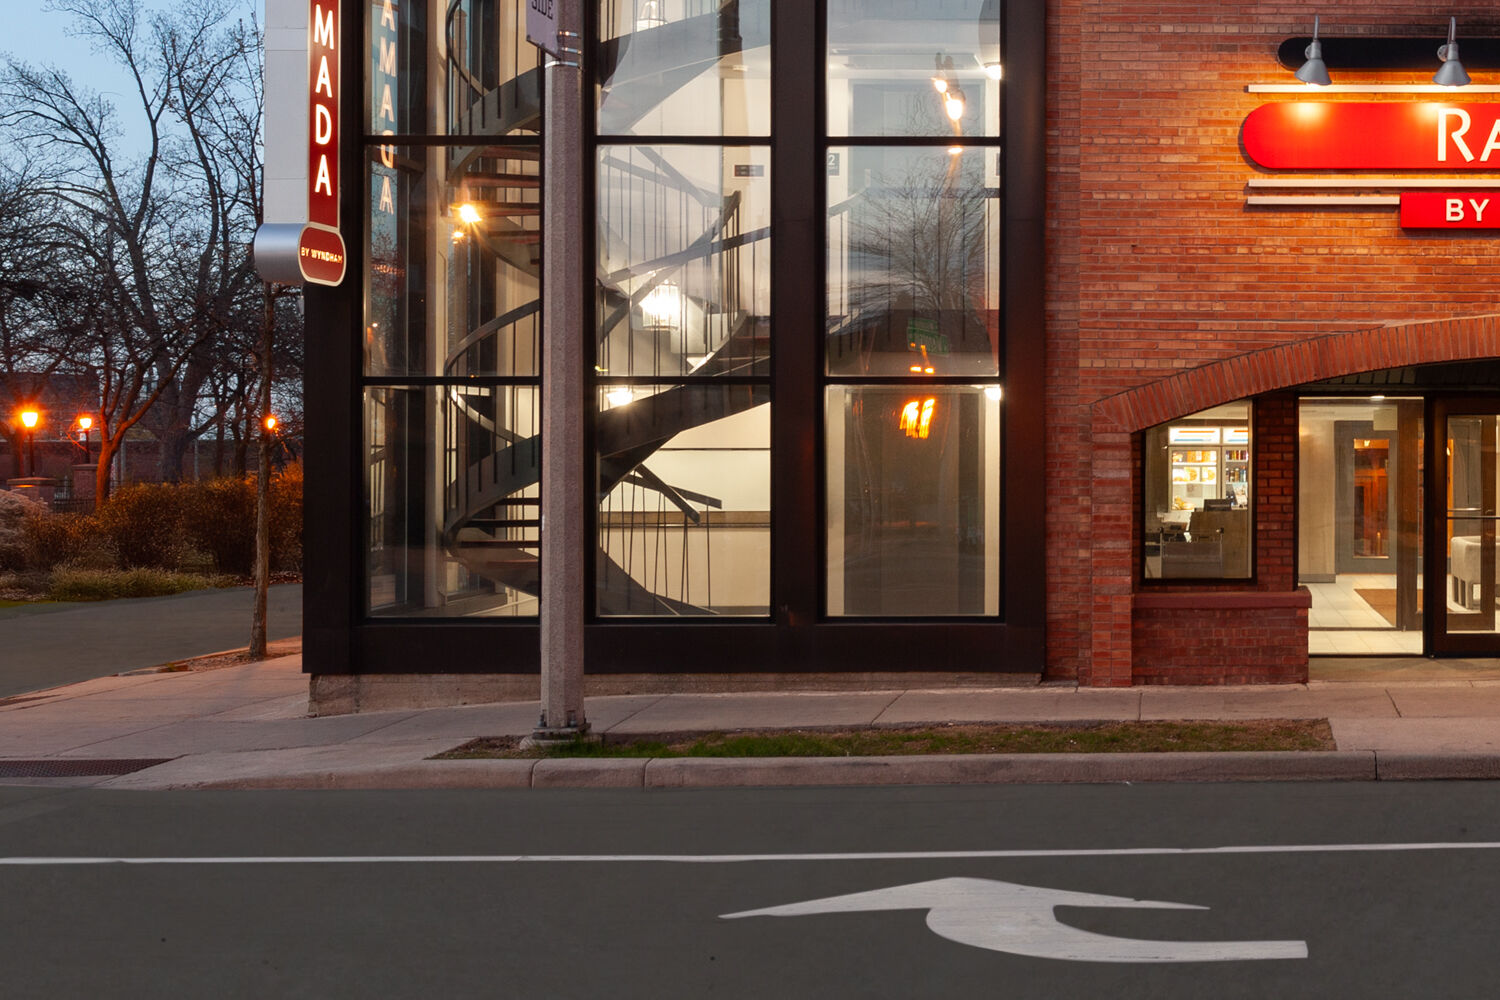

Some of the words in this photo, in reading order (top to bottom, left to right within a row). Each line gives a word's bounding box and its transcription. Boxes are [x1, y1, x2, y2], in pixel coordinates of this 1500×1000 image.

[1446, 199, 1489, 222] BY
[301, 246, 310, 257] BY
[310, 248, 343, 264] WYNDHAM
